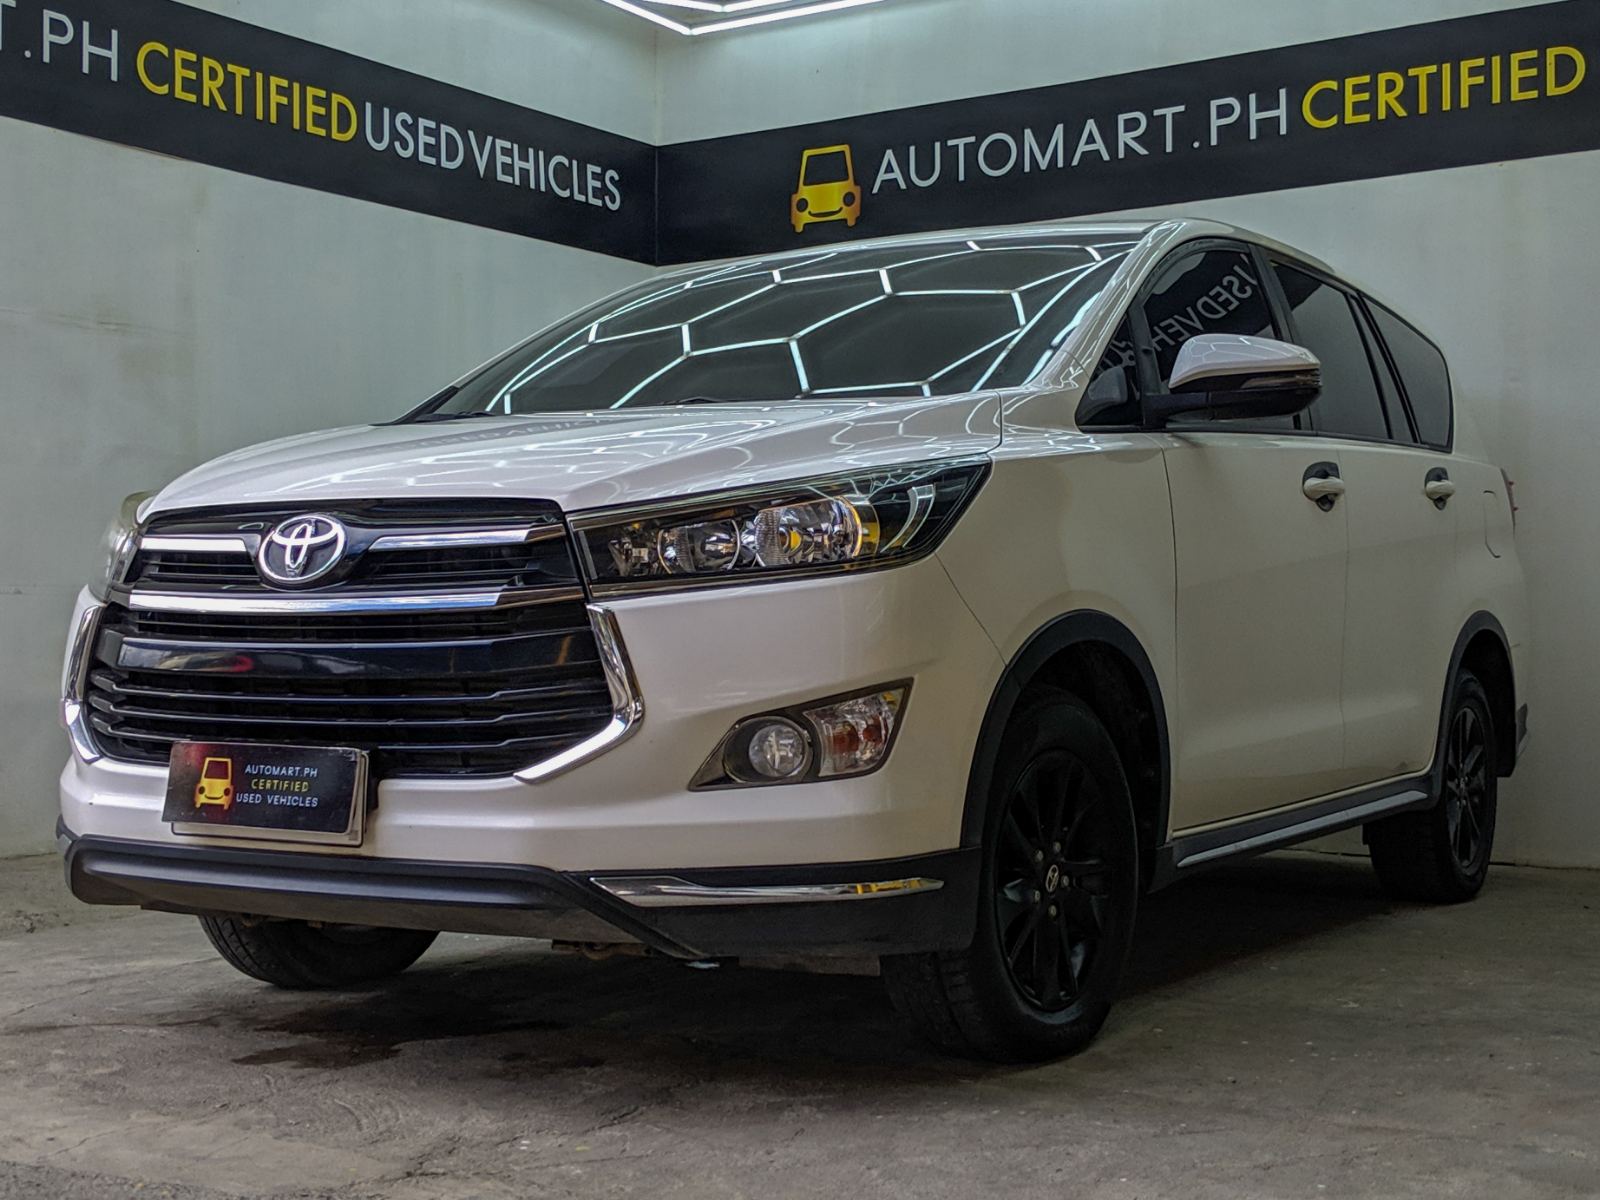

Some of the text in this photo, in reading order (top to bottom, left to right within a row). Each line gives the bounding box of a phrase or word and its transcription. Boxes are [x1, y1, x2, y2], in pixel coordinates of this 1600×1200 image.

[136, 41, 358, 142] CERTIFIED
[871, 46, 1587, 195] AUTOMART.PH CERTIFIED
[244, 764, 318, 778] AUTOMART.PH
[251, 778, 309, 792] CERTIFIED
[236, 793, 319, 807] USED VEHICLES
